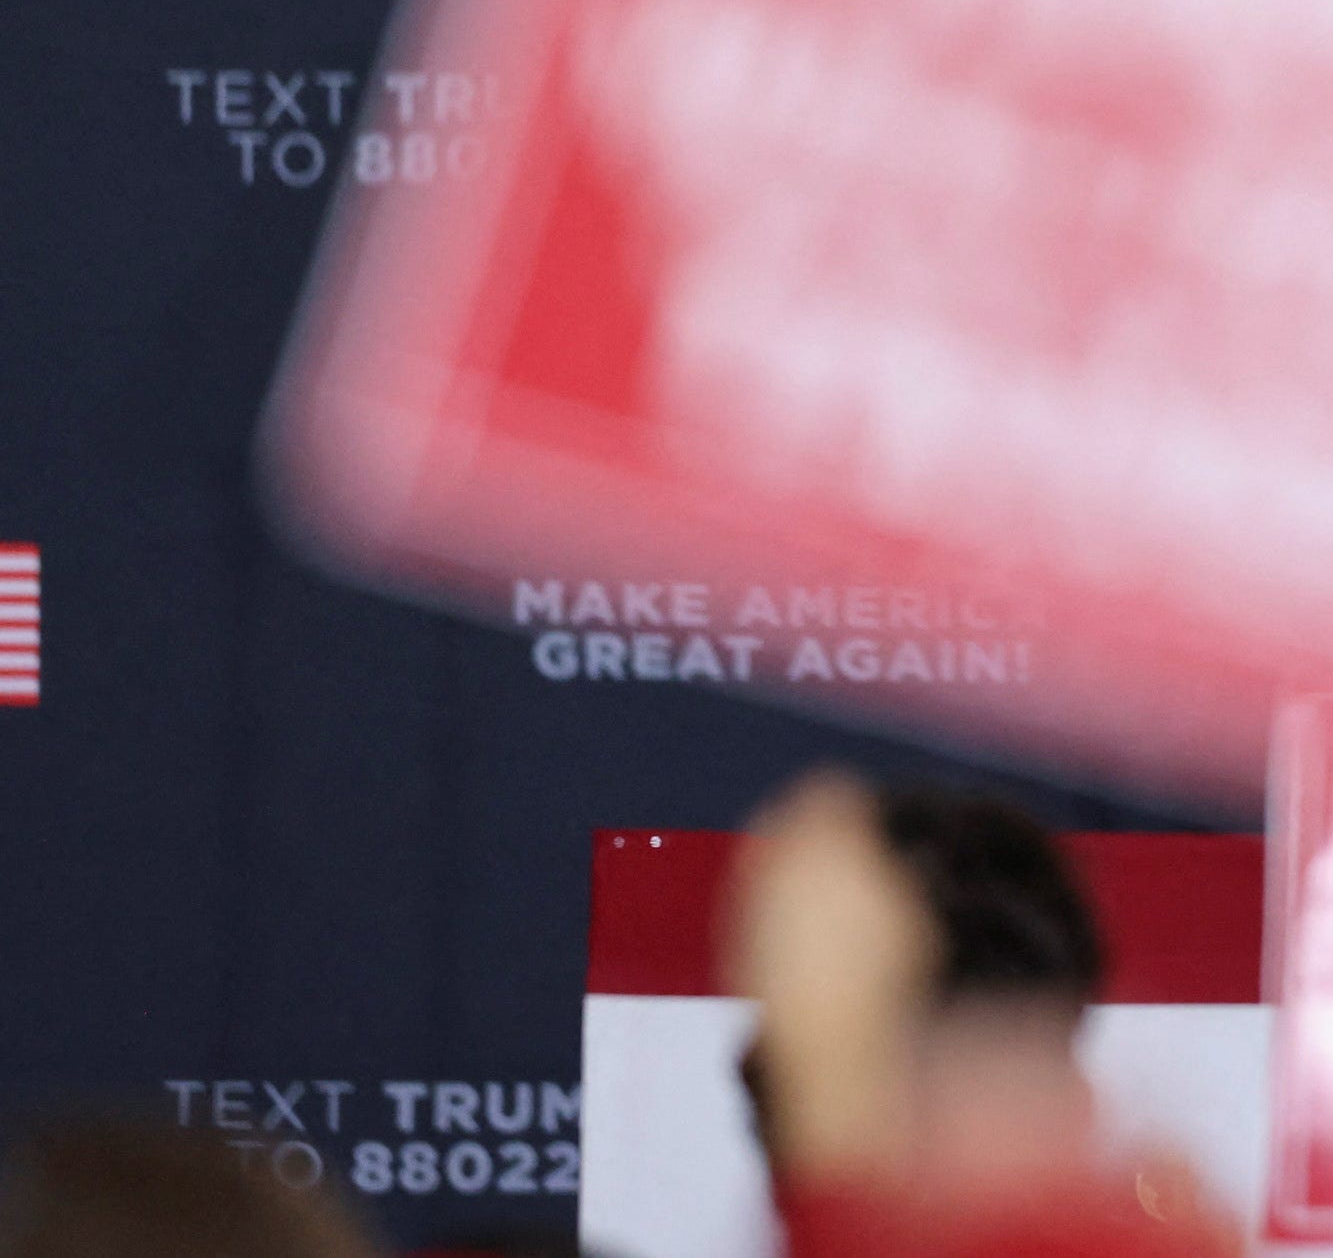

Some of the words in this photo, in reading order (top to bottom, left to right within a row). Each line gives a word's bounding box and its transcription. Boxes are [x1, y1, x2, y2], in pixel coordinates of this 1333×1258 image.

[166, 67, 355, 128] TEXT
[228, 130, 327, 189] TO
[355, 130, 492, 183] 880
[511, 578, 711, 627] MAKE
[531, 630, 765, 683] GREAT
[788, 634, 1032, 685] AGAIN!
[164, 1078, 356, 1134] TEXT
[384, 1080, 582, 1136] TRUM
[352, 1140, 582, 1196] 88022
